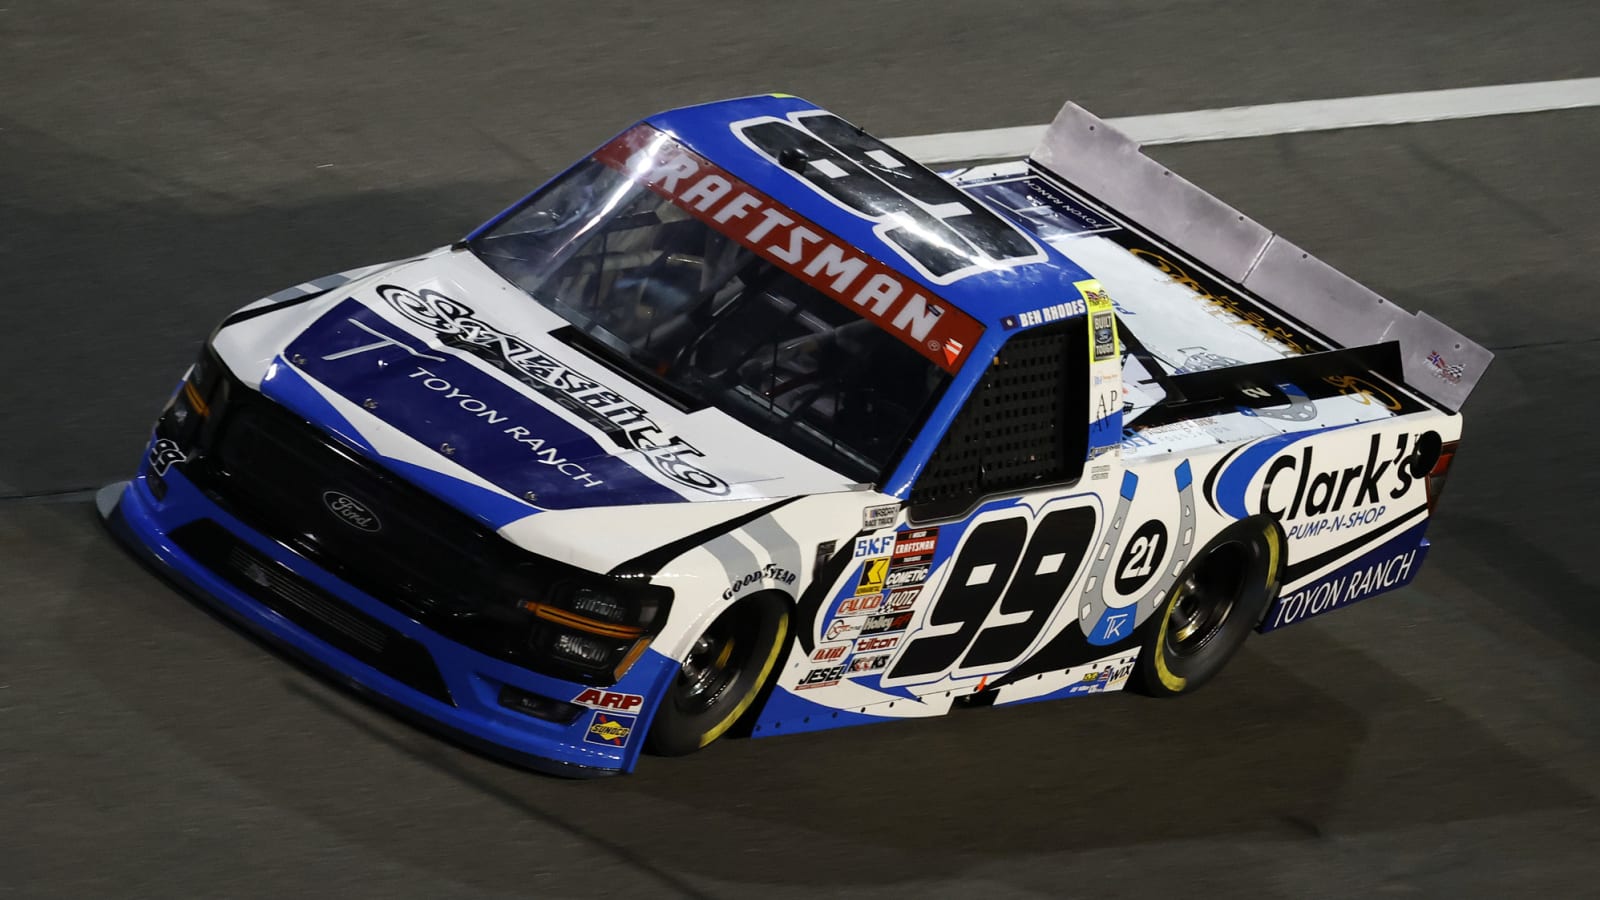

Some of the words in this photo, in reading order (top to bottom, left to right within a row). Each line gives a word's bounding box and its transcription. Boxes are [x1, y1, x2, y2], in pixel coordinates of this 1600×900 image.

[1023, 180, 1063, 204] RANCH
[1062, 205, 1107, 228] TOYON
[1019, 310, 1042, 328] BEN
[1042, 299, 1086, 322] RHODES
[1094, 315, 1111, 330] BUILT
[409, 367, 508, 425] TOYON
[504, 426, 604, 488] RANCH
[1260, 432, 1415, 522] Clark's
[331, 497, 372, 528] Ford
[1287, 506, 1387, 541] PUMP-N-SHOP
[855, 536, 895, 558] SKF
[895, 540, 935, 554] CRAFTSMAN
[1120, 533, 1160, 580] 21
[886, 568, 928, 585] COMETIC
[886, 589, 920, 607] KLOTZ
[888, 504, 1097, 681] 99
[1274, 576, 1347, 628] TOYON
[1343, 549, 1417, 602] RANCH
[838, 595, 882, 615] CALICO
[857, 637, 899, 652] tilton
[798, 666, 846, 685] JESEL
[1109, 664, 1132, 682] WIX
[575, 689, 643, 710] ARP
[591, 723, 630, 738] SUNOCO
